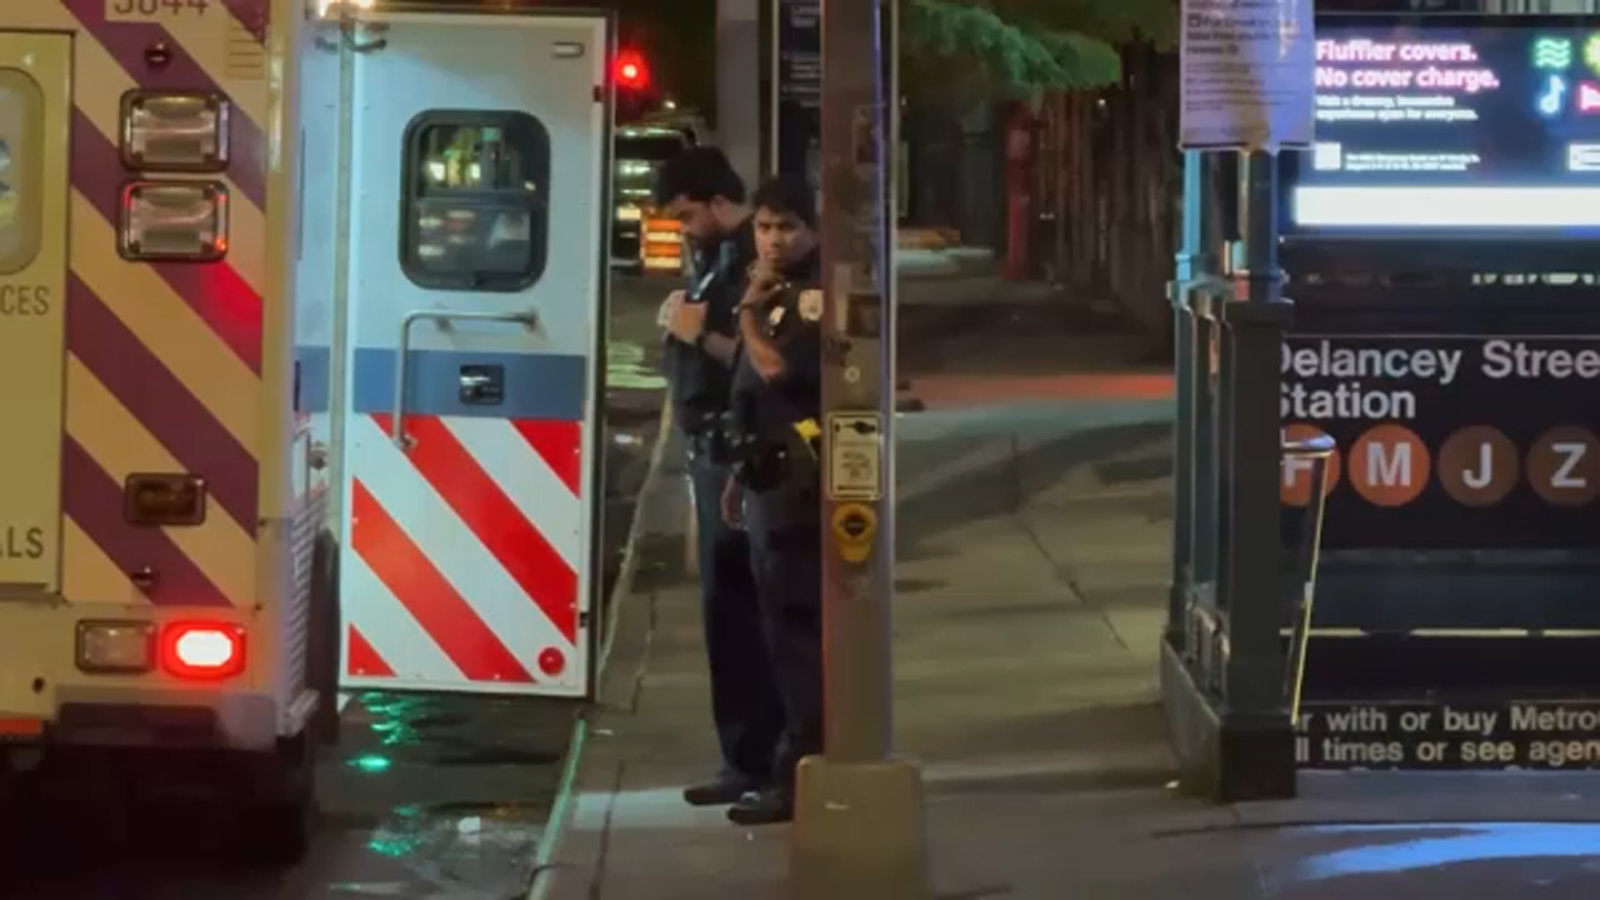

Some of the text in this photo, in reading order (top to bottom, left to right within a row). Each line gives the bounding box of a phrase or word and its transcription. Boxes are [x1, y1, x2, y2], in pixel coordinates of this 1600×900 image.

[1399, 44, 1478, 61] covers.
[1315, 67, 1348, 87] No
[1352, 70, 1413, 87] cover
[1416, 66, 1500, 92] charge.
[1482, 340, 1600, 378] Stree
[1281, 382, 1416, 418] tation
[1366, 442, 1411, 486] M
[1463, 442, 1492, 488] J
[1551, 443, 1586, 487] Z
[0, 526, 44, 559] LS
[1326, 707, 1387, 731] with
[1400, 712, 1430, 731] or
[1444, 706, 1498, 736] buy
[1510, 705, 1600, 731] Metro
[1295, 736, 1310, 762] ll
[1323, 736, 1404, 762] times
[1416, 742, 1448, 761] or
[1460, 742, 1516, 761] see
